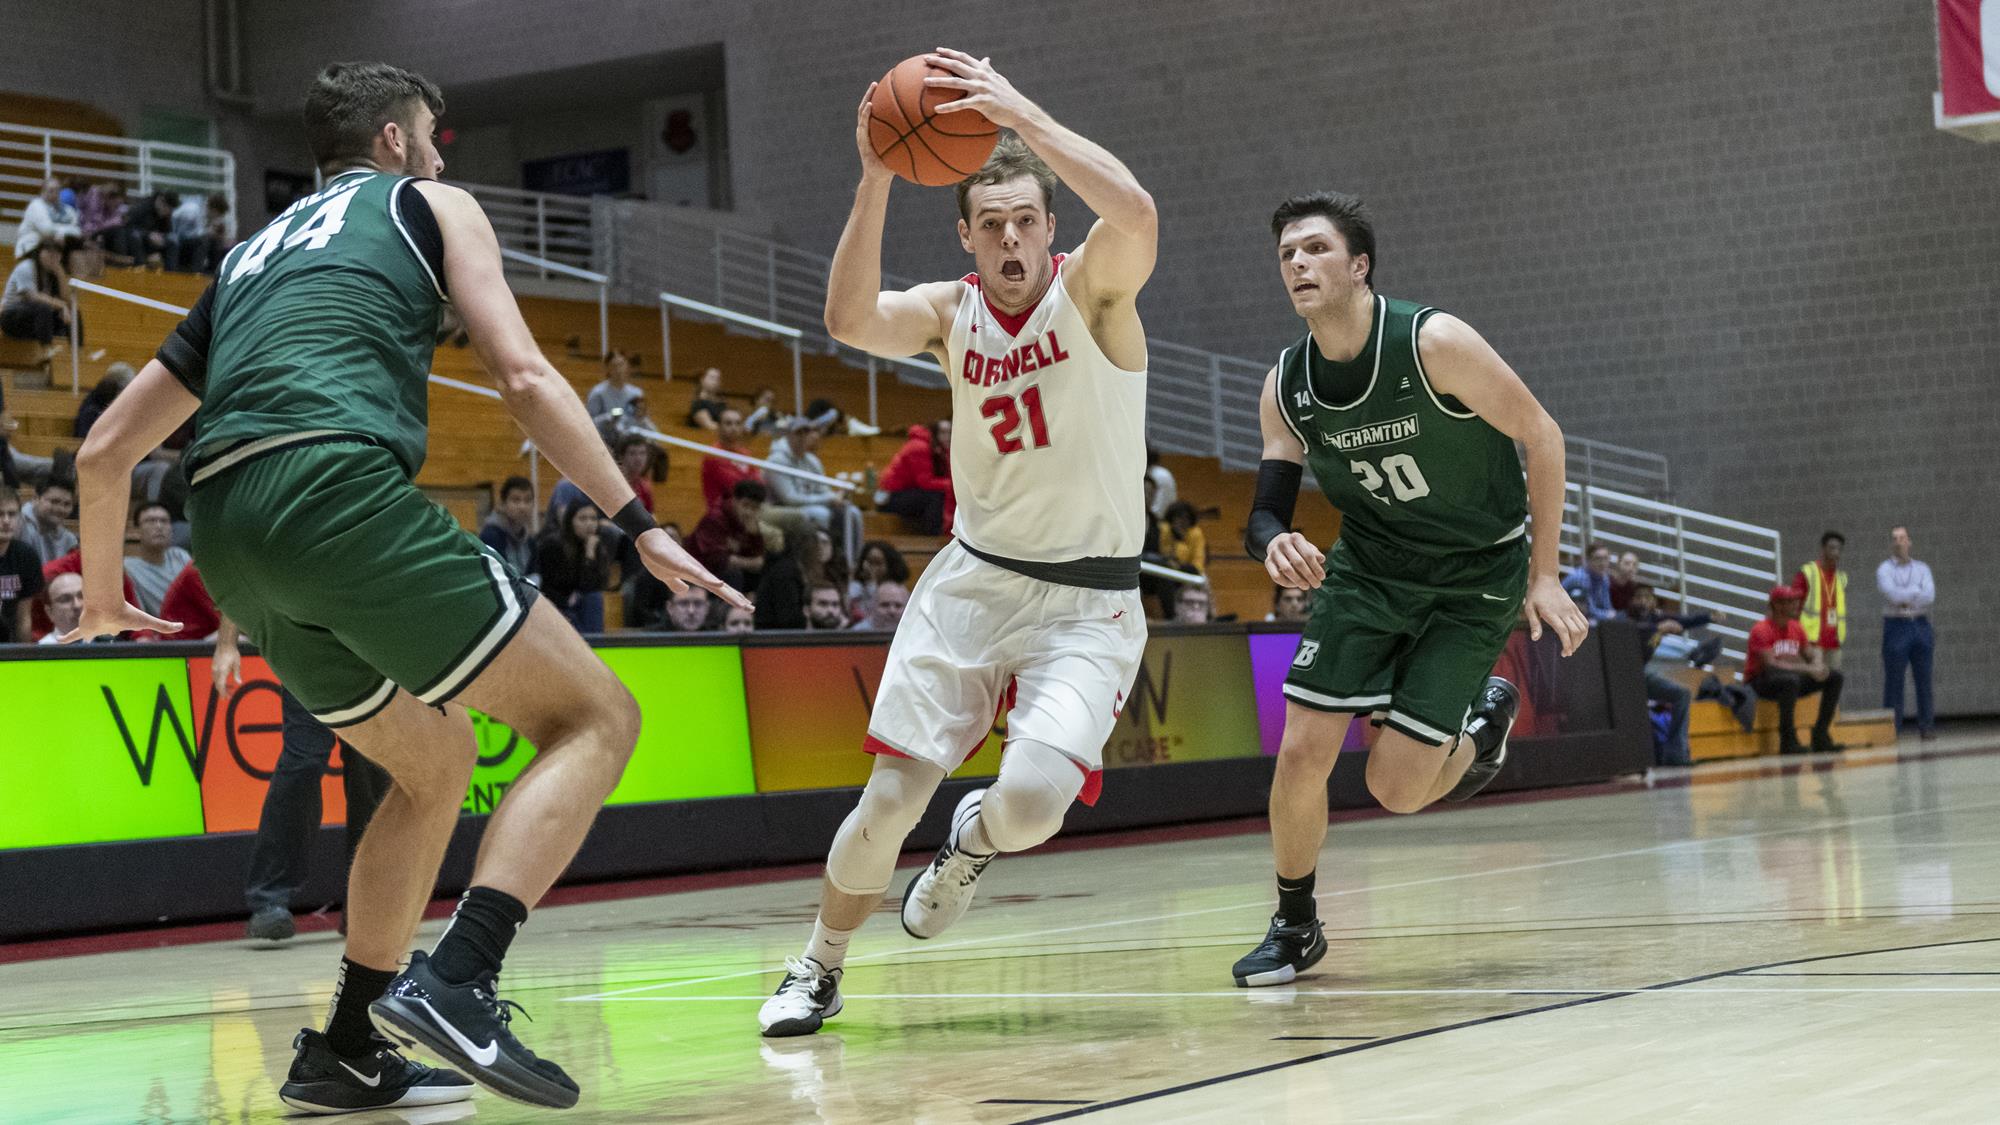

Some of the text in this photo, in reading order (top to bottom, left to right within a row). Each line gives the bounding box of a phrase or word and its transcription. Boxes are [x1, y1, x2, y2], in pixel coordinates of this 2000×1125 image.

[227, 185, 361, 285] 44
[979, 383, 1051, 455] 21
[1293, 390, 1311, 408] 14
[1324, 416, 1416, 450] NGHAMTON
[1350, 453, 1430, 507] 20
